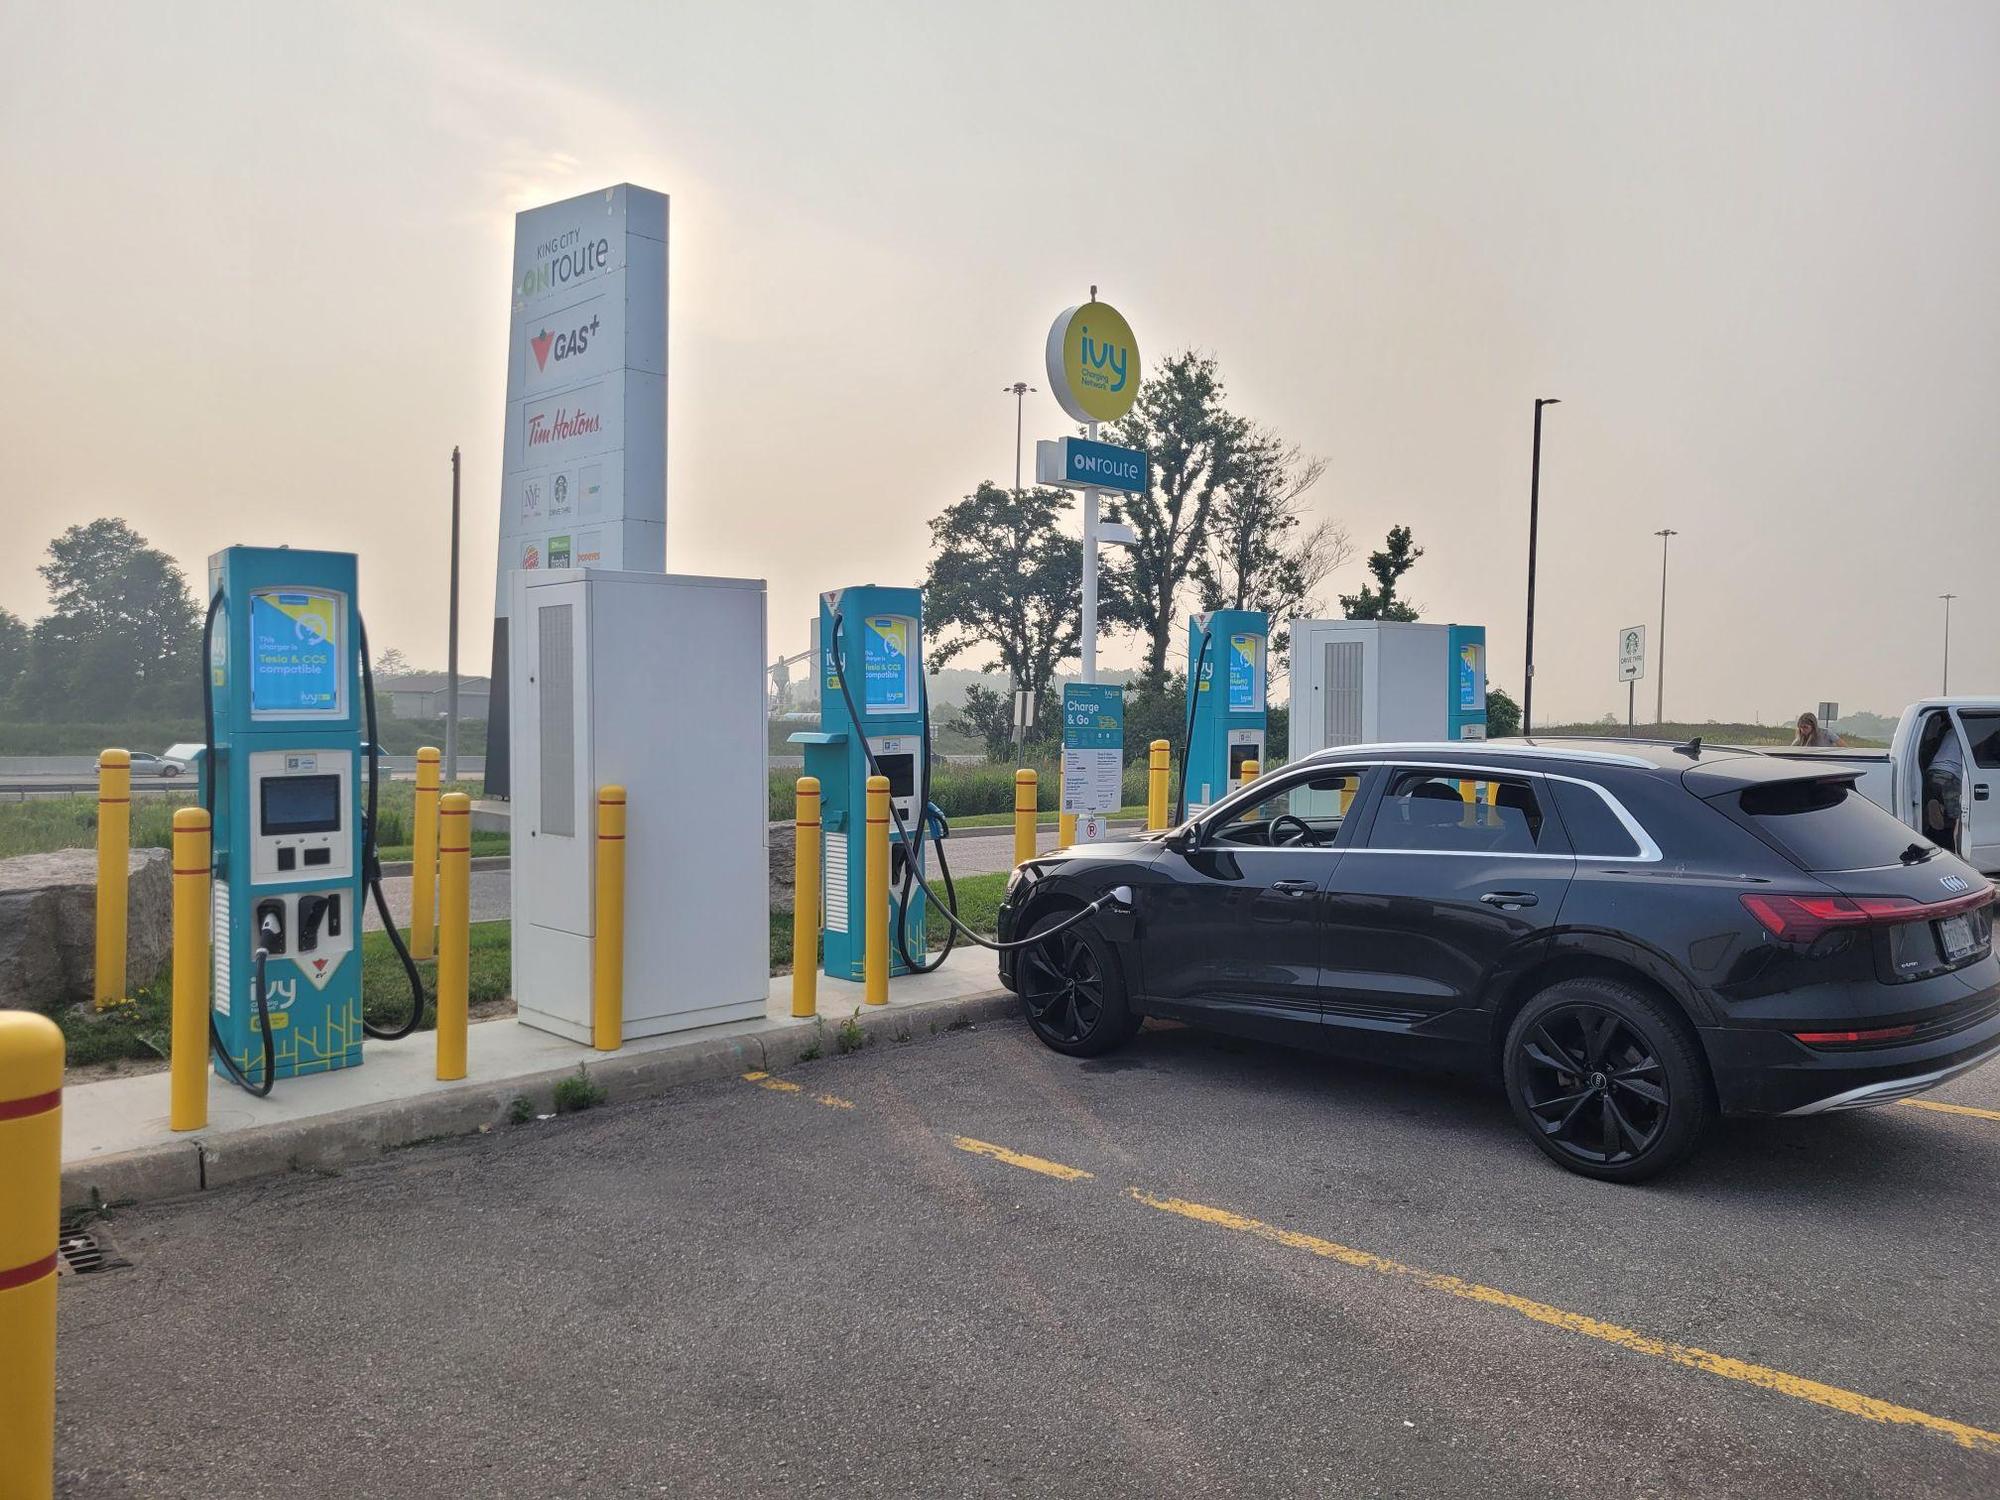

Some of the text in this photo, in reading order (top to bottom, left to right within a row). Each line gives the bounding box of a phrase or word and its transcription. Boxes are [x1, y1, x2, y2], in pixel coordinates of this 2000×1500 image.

[537, 227, 581, 260] KING CITY
[1081, 326, 1126, 392] ivy
[528, 408, 602, 447] Tim Hortons
[1074, 453, 1139, 479] ONroute
[259, 655, 288, 664] Tesla
[302, 655, 327, 664] CCS
[259, 665, 322, 676] compatible
[1067, 700, 1099, 714] Charge
[1067, 714, 1090, 725] & Go
